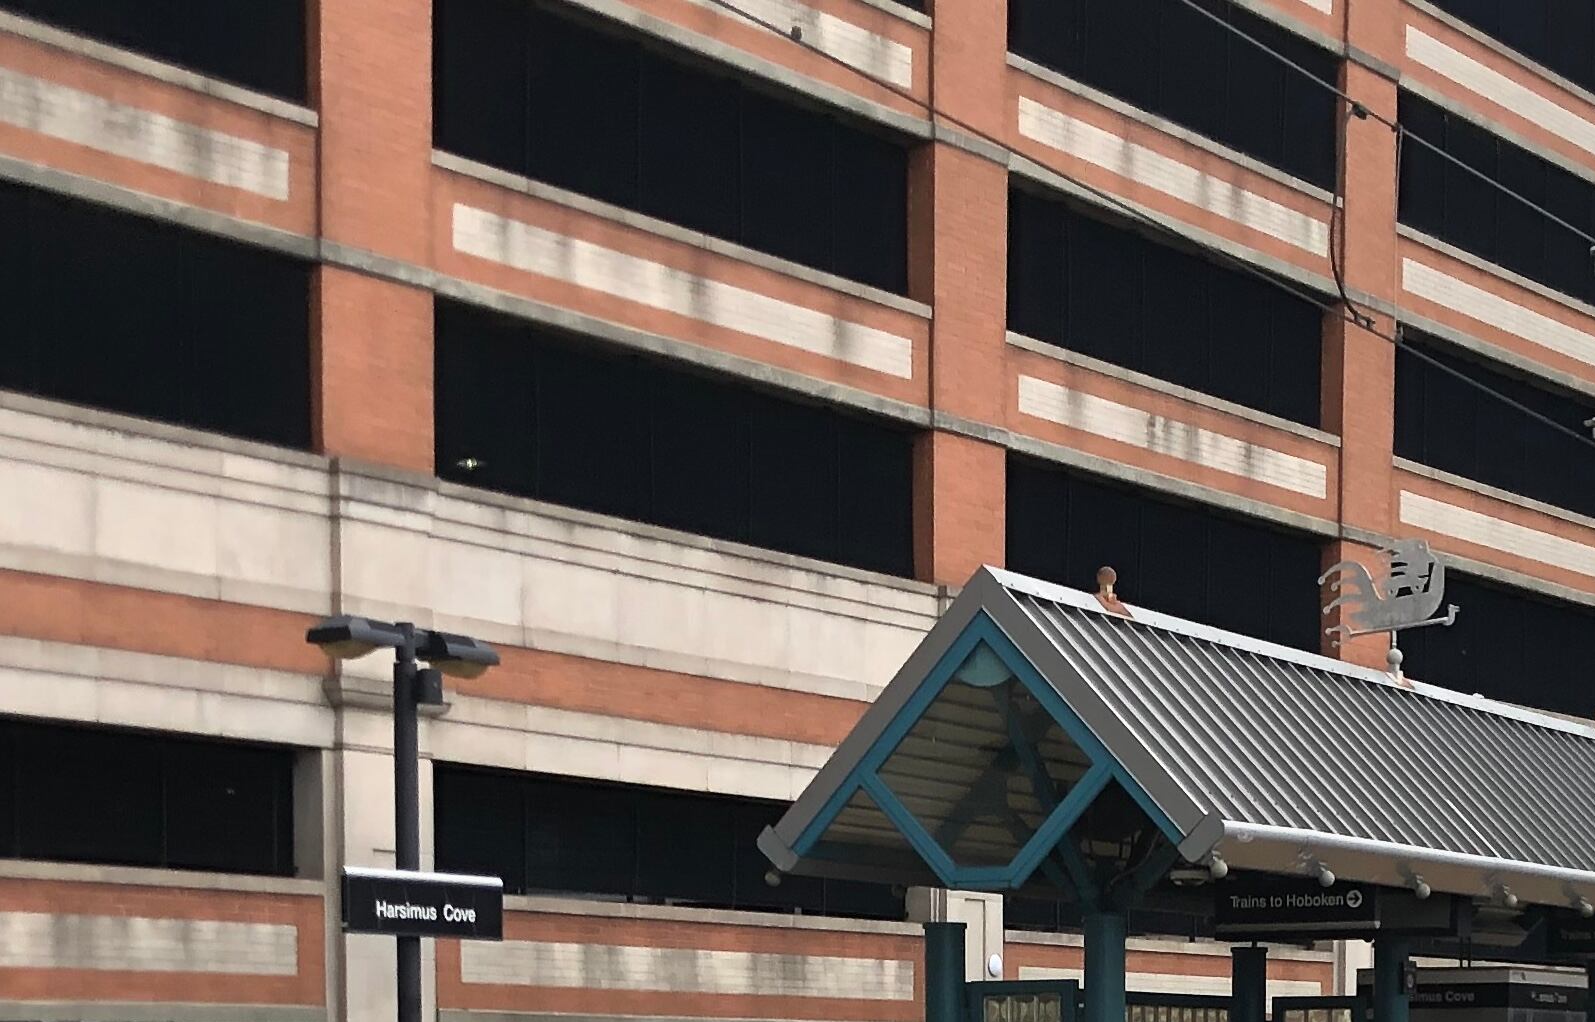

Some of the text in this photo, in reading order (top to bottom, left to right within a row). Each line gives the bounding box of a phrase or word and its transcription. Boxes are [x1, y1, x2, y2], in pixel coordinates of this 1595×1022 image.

[1230, 894, 1344, 908] Trains to Hoboken
[375, 900, 476, 922] Harsimus Cove
[1445, 990, 1475, 1002] Cove
